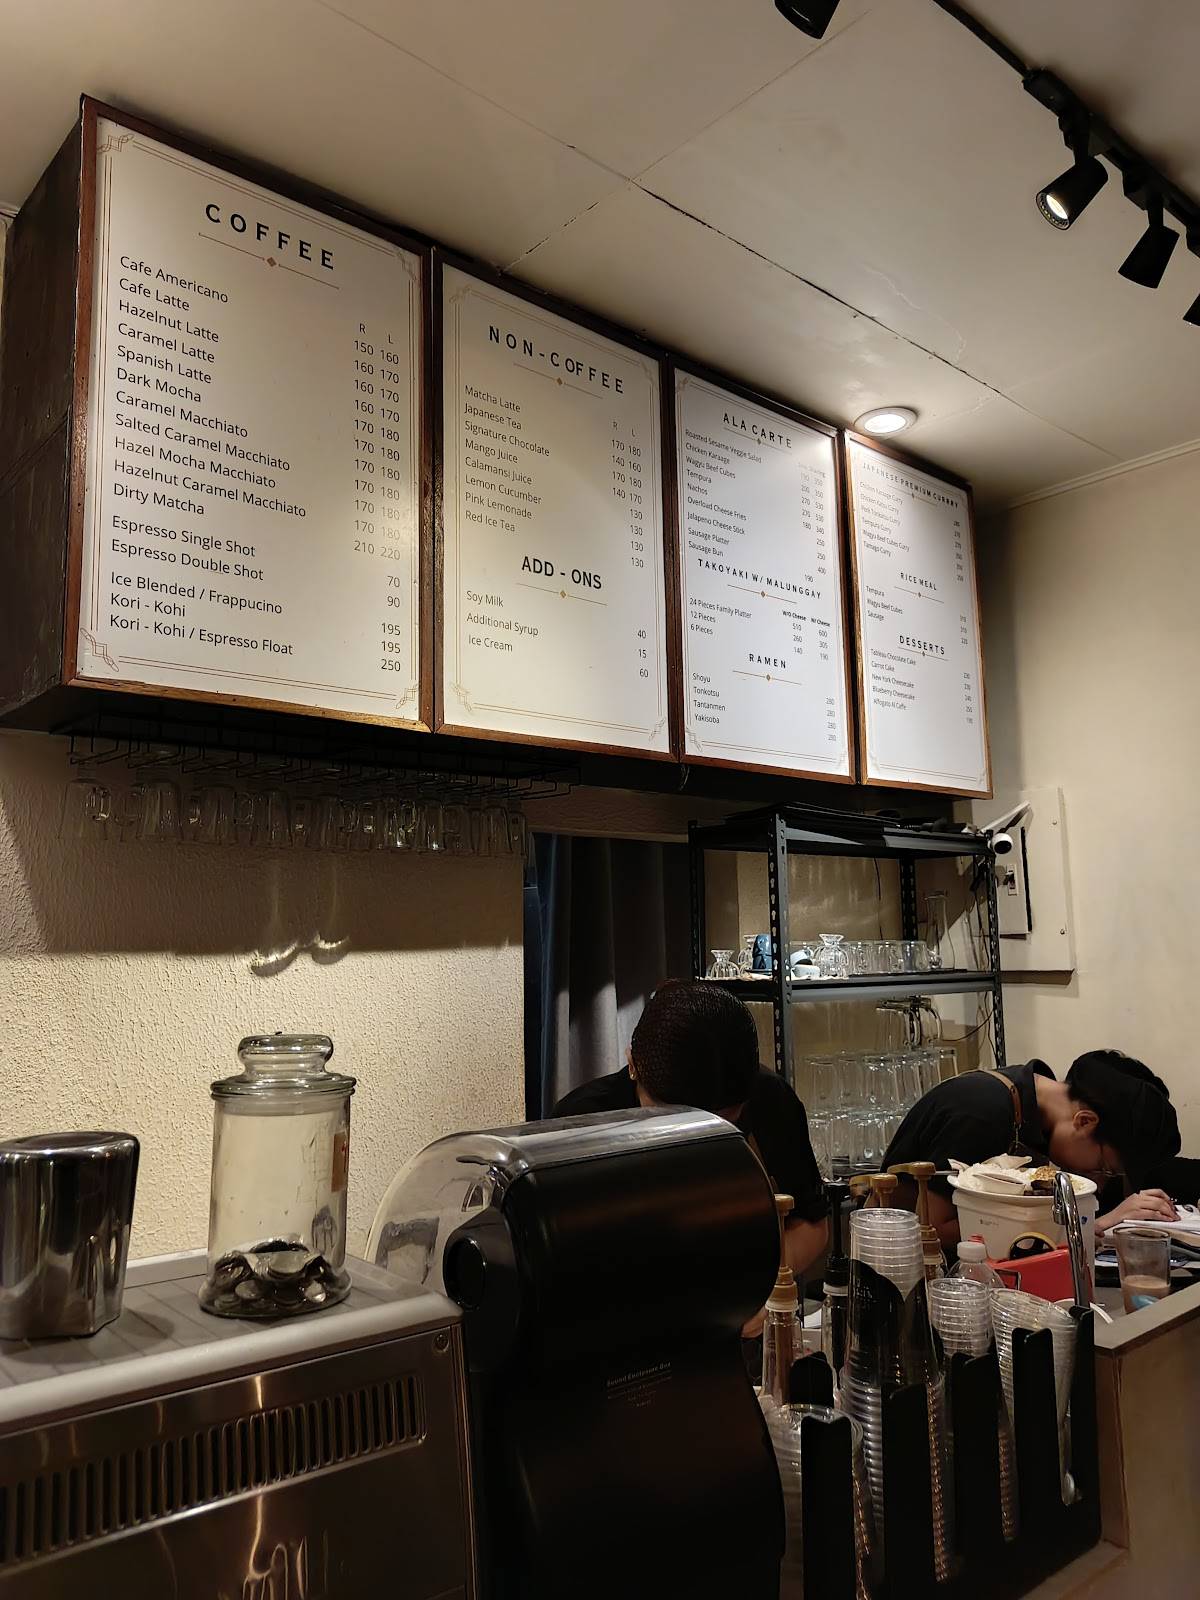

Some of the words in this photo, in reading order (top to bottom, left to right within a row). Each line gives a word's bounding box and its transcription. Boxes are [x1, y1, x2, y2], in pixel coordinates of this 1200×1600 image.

[205, 201, 334, 270] COFFEE
[119, 277, 151, 298] Cafe
[155, 290, 190, 312] Latte
[354, 360, 374, 376] 160
[380, 369, 399, 385] 170
[120, 254, 152, 276] Cafe
[156, 267, 228, 303] Americano
[354, 340, 374, 356] 150
[380, 350, 399, 365] 160
[359, 323, 366, 335] R
[388, 334, 393, 345] L
[118, 322, 177, 352] Caramel
[181, 343, 215, 364] Latte
[354, 399, 374, 415] 160
[380, 408, 400, 423] 170
[119, 300, 181, 331] Hazelnut
[186, 322, 219, 343] Latte
[354, 379, 374, 395] 160
[380, 388, 399, 404] 170
[489, 325, 623, 394] NON-COFFEE
[117, 345, 173, 373] Spanish
[178, 364, 212, 384] Latte
[354, 419, 374, 435] 170
[380, 427, 400, 443] 180
[117, 368, 151, 389] Dark
[155, 379, 201, 403] Mocha
[355, 439, 374, 455] 170
[381, 447, 400, 462] 180
[465, 385, 497, 405] Matcha
[500, 398, 521, 413] Latte
[611, 439, 625, 452] 170
[629, 445, 641, 458] 180
[115, 414, 160, 437] Salted
[164, 427, 221, 453] Caramel
[226, 444, 290, 471] Macchiato
[355, 479, 374, 494] 170
[381, 487, 400, 501] 180
[116, 390, 175, 418] Caramel
[180, 409, 248, 438] Macchiato
[355, 459, 374, 474] 170
[381, 466, 400, 481] 180
[464, 402, 504, 425] Japanese
[506, 417, 522, 431] Tea
[612, 455, 625, 467] 140
[629, 461, 641, 473] 160
[465, 420, 507, 443] Signature
[509, 435, 550, 457] Chocolate
[612, 471, 625, 483] 170
[629, 477, 642, 489] 180
[632, 429, 635, 437] L
[752, 424, 792, 449] CARTE
[114, 460, 178, 486] Hazelnut
[182, 477, 239, 501] Caramel
[243, 492, 306, 517] Macchiato
[354, 520, 374, 534] 170
[381, 527, 400, 541] 180
[115, 437, 154, 458] Hazel
[159, 449, 205, 471] Mocha
[210, 462, 276, 489] Macchiato
[354, 499, 374, 514] 170
[381, 506, 400, 521] 180
[465, 438, 496, 458] Mango
[497, 449, 518, 464] Juice
[612, 487, 625, 499] 140
[630, 493, 642, 505] 170
[465, 456, 510, 479] Calamansi
[512, 471, 532, 485] Juice
[630, 509, 643, 520] 130
[114, 483, 149, 506] Dirty
[153, 492, 204, 515] Matcha
[354, 540, 374, 555] 210
[380, 547, 400, 561] 220
[465, 474, 496, 492] Lemon
[499, 484, 541, 505] Cucumber
[631, 525, 643, 536] 130
[465, 492, 485, 506] Pink
[487, 498, 532, 520] Lemonade
[631, 541, 644, 552] 130
[112, 516, 177, 540] Espresso
[181, 531, 222, 551] Single
[226, 540, 256, 557] Shot
[387, 576, 400, 588] 70
[466, 510, 482, 524] Red
[485, 516, 497, 528] Ice
[500, 520, 515, 533] Tea
[631, 557, 644, 568] 130
[111, 539, 176, 563] Espresso
[181, 554, 230, 574] Double
[233, 564, 264, 581] Shot
[387, 596, 400, 608] 90
[111, 572, 132, 587] Ice
[137, 577, 195, 598] Blended
[199, 588, 205, 600] /
[209, 590, 282, 614] Frappucino
[381, 623, 401, 636] 195
[521, 556, 554, 578] ADD
[571, 568, 602, 590] ONS
[698, 559, 748, 579] TAKOYAKI
[766, 578, 821, 599] MALUNGGAY
[900, 573, 917, 584] RICE
[918, 578, 937, 590] MEAL
[110, 593, 140, 610] Kori
[154, 601, 186, 617] Kohi
[381, 641, 401, 654] 195
[110, 615, 140, 631] Kori
[153, 622, 186, 638] Kohi
[188, 628, 194, 640] /
[199, 630, 258, 650] Espresso
[262, 640, 293, 655] Float
[381, 659, 401, 672] 250
[466, 590, 483, 606] Soy
[485, 595, 504, 608] Milk
[637, 629, 646, 639] 40
[467, 612, 512, 631] Additional
[514, 622, 539, 639] Syrup
[638, 649, 647, 658] 15
[899, 635, 945, 655] DESSERTS
[468, 635, 481, 646] Ice
[484, 638, 513, 652] Cream
[639, 668, 649, 678] 60
[692, 673, 711, 684] Shoyu
[749, 654, 786, 669] RAMEN
[693, 687, 720, 698] Tonkotsu
[694, 700, 726, 712] Tantanmen
[695, 714, 720, 724] Yakisoba
